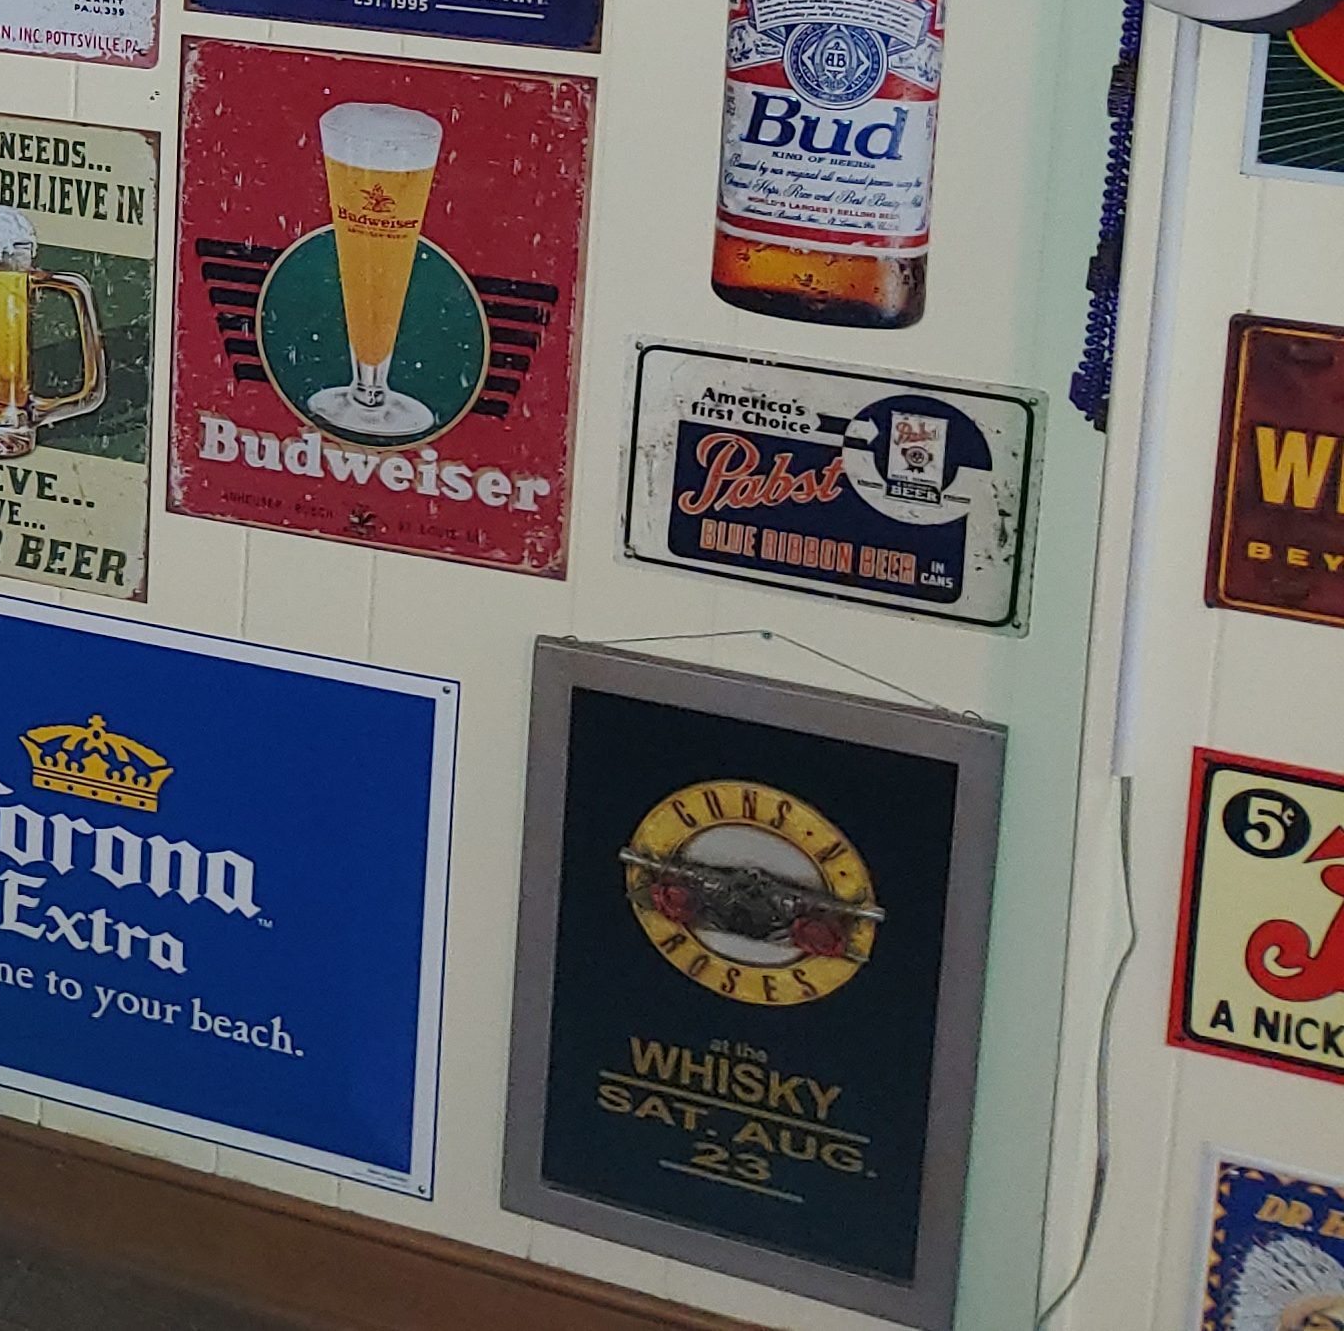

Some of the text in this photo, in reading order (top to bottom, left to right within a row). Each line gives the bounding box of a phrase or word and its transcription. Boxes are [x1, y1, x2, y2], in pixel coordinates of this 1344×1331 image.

[739, 90, 910, 161] Bud
[772, 151, 803, 161] KING
[0, 171, 109, 221] BELIEVE
[701, 386, 806, 418] America's
[742, 410, 811, 434] Choice
[197, 415, 552, 514] Budweiser
[677, 432, 847, 516] Pabst
[889, 483, 939, 503] BEER
[16, 533, 128, 587] BEER
[761, 528, 853, 574] RIBBON
[1210, 999, 1234, 1033] A
[629, 1034, 843, 1122] WHISKY
[597, 1083, 716, 1139] SAT.
[690, 1141, 773, 1183] 23
